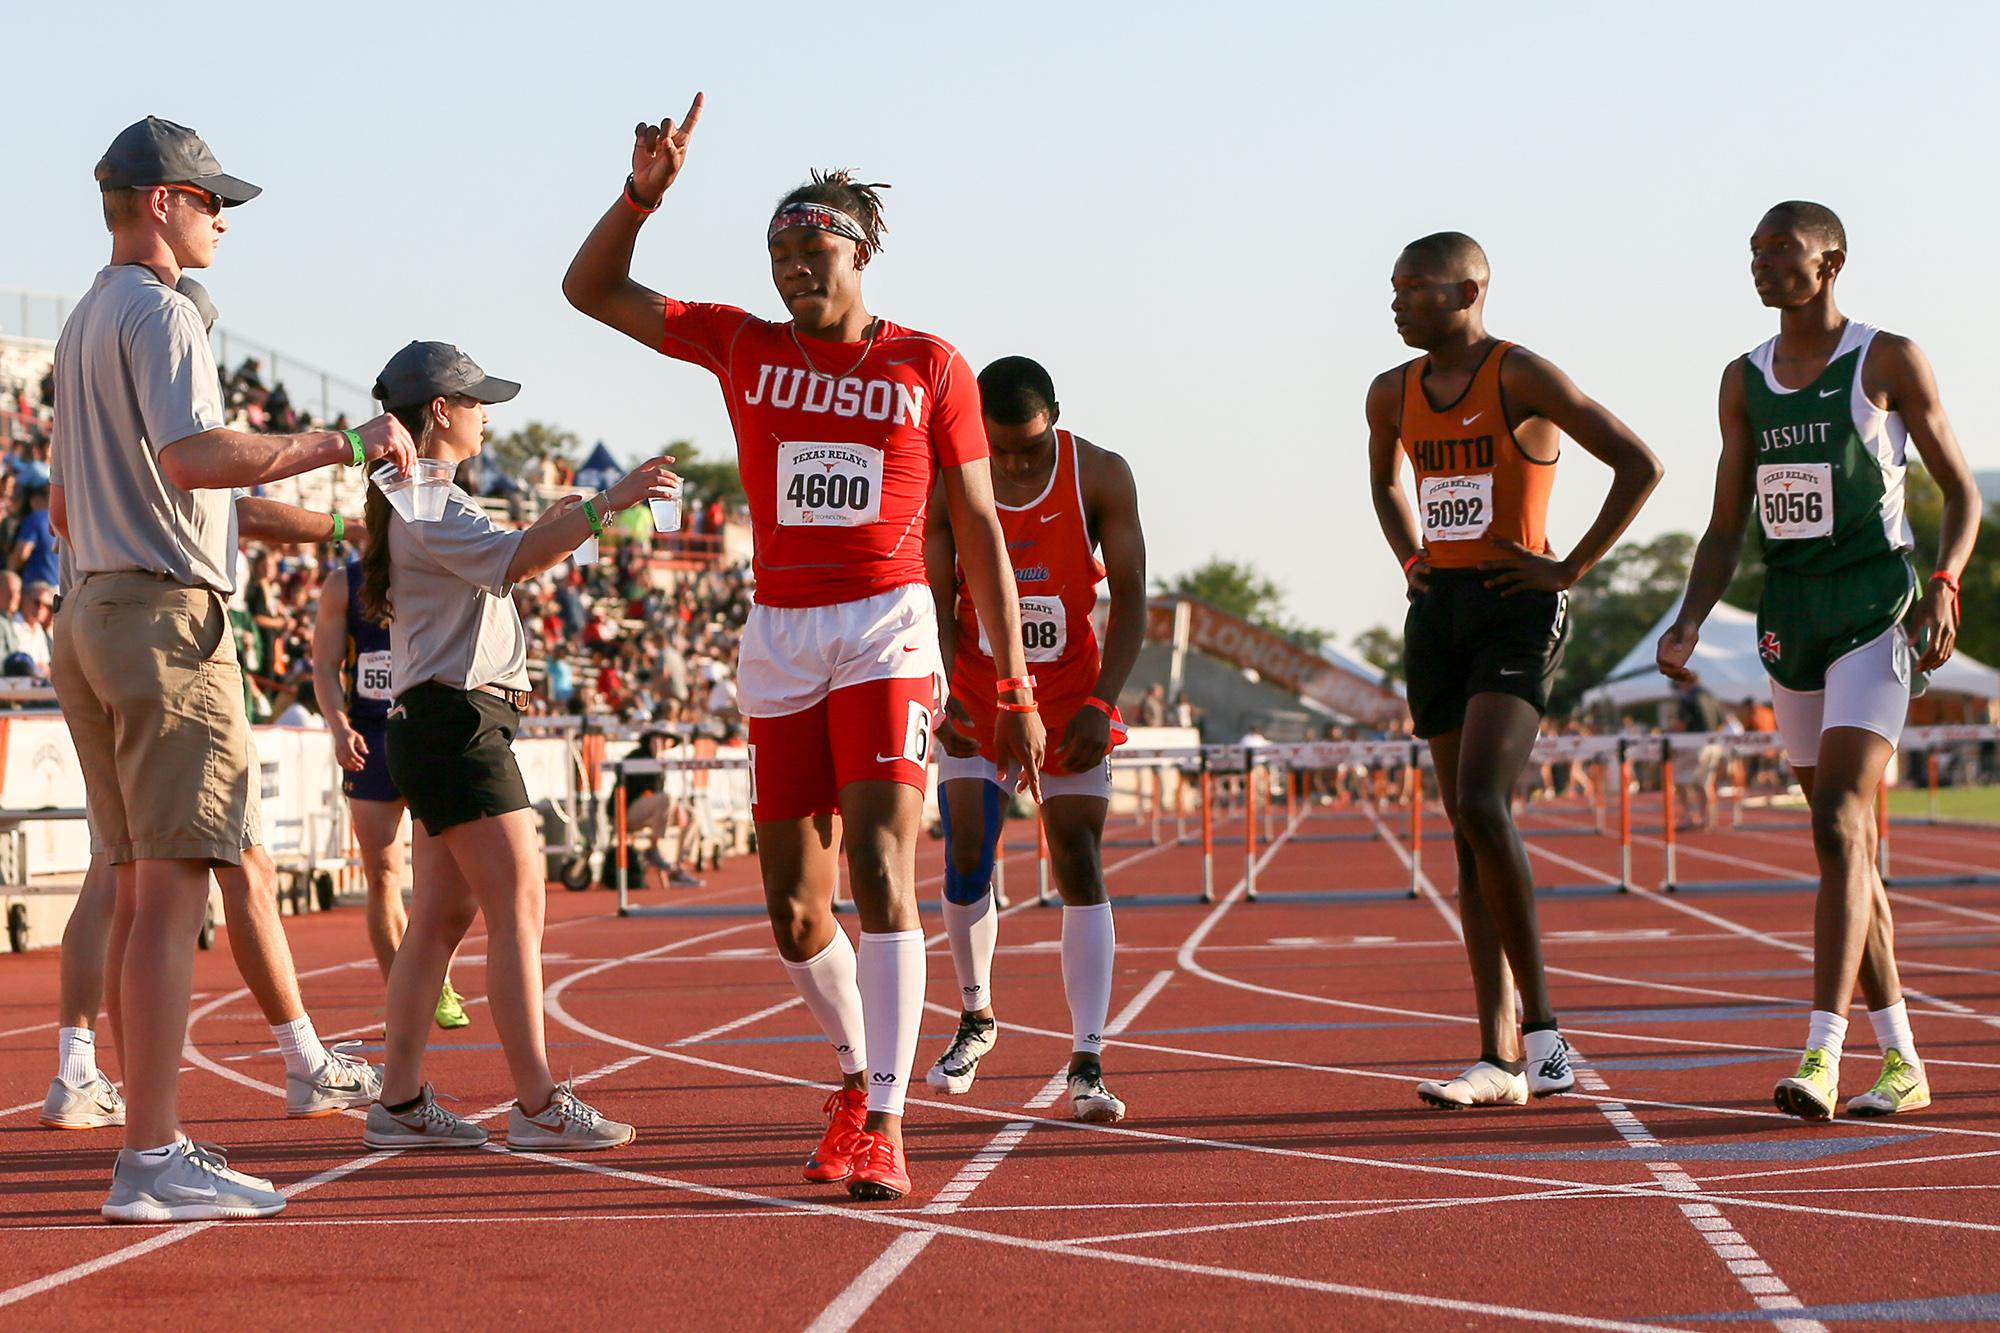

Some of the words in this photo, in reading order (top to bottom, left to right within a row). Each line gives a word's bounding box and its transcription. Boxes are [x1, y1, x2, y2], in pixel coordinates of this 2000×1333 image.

[745, 364, 924, 428] JUDSON
[1761, 423, 1831, 452] JESUIT
[792, 450, 826, 465] TEXAS
[828, 450, 868, 468] RELAYS
[1413, 435, 1493, 471] HUTTO
[787, 474, 870, 510] 4600
[1450, 481, 1481, 490] RELAYS
[1763, 471, 1784, 486] TEXAS
[1785, 471, 1819, 485] RELAYS
[1427, 497, 1483, 528] 5092
[1764, 492, 1822, 524] 5056
[1022, 621, 1057, 649] 08
[364, 669, 392, 689] 55
[915, 710, 928, 761] 6
